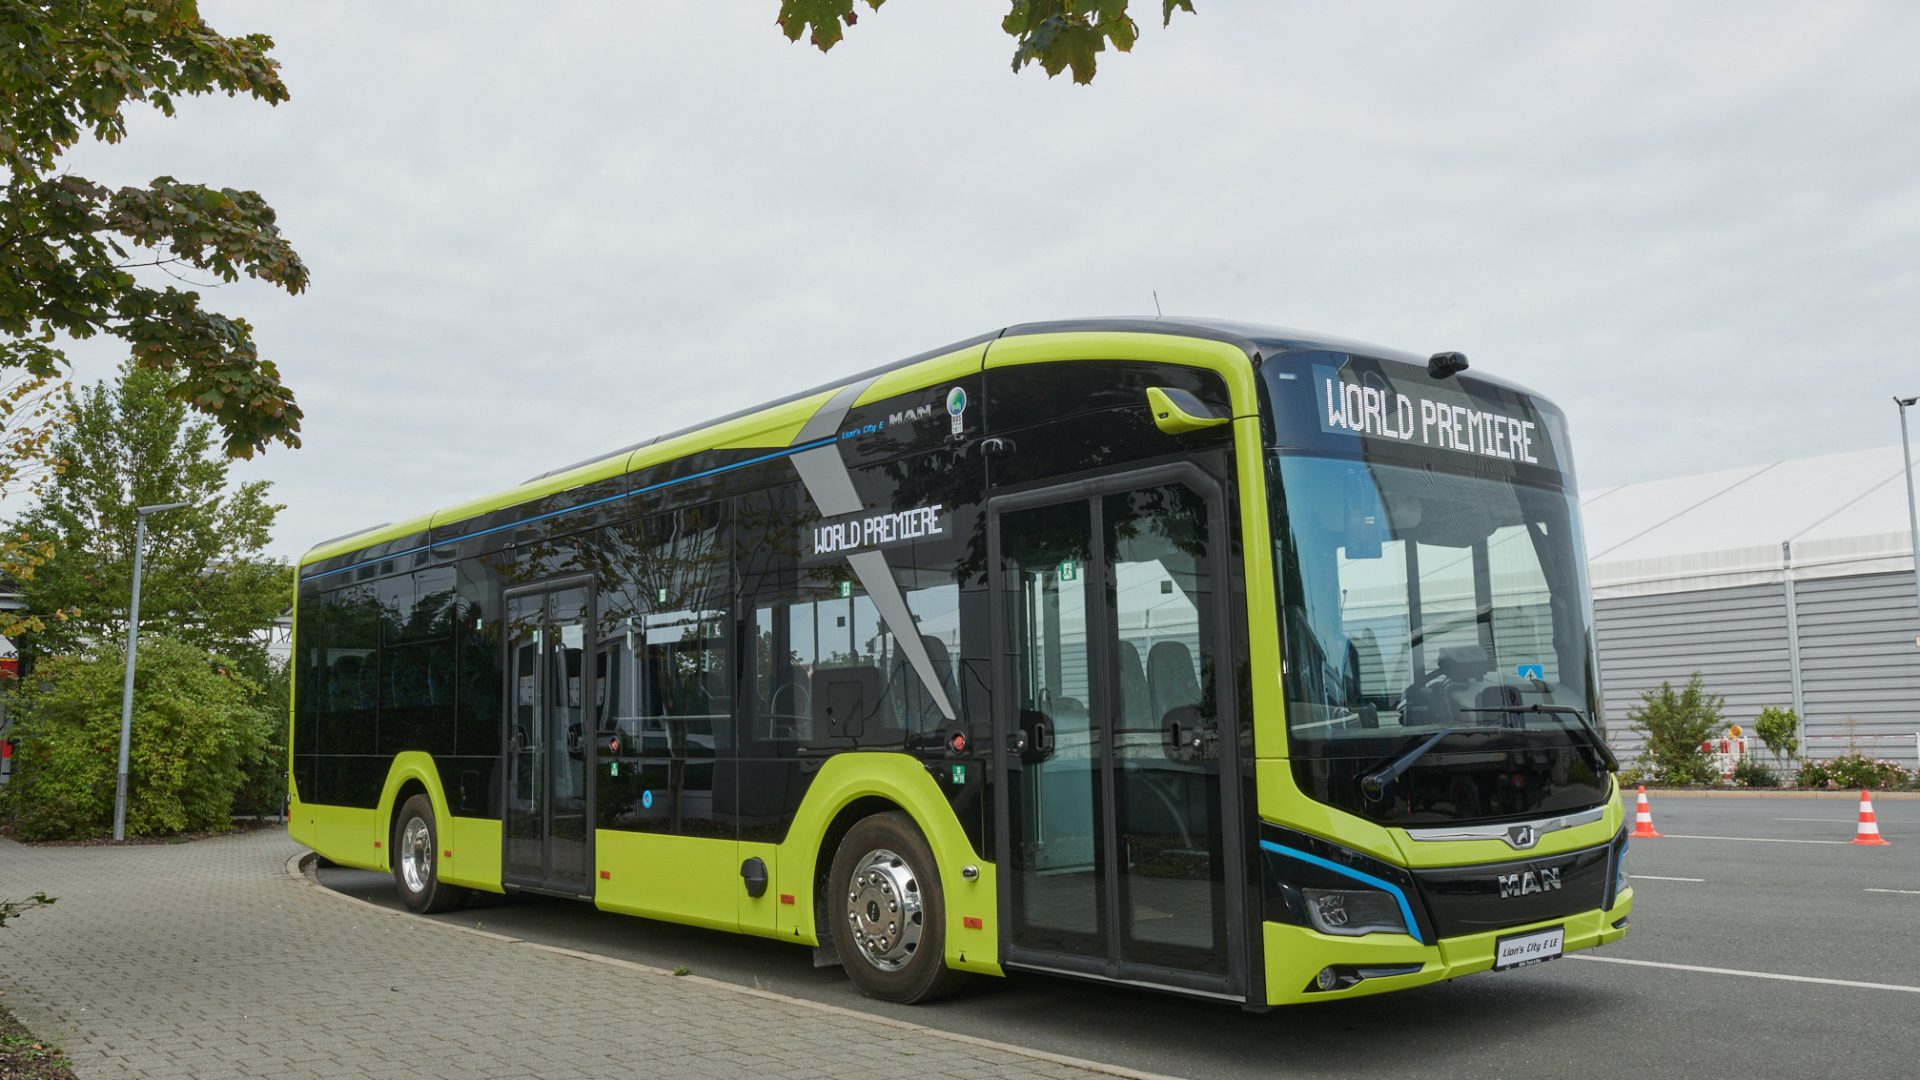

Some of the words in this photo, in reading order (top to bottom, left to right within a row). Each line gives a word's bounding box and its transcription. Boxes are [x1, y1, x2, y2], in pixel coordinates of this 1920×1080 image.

[889, 404, 932, 427] MAN
[1326, 378, 1413, 441] WORLD
[1420, 399, 1538, 464] PREMIERE
[841, 428, 861, 439] Lion's
[863, 424, 877, 434] City
[879, 420, 884, 430] E
[814, 521, 861, 555] WORLD
[864, 504, 943, 546] PREMIERE
[1498, 867, 1562, 899] MAN
[1503, 945, 1524, 957] Lion's
[1527, 941, 1541, 952] City
[1543, 940, 1548, 949] E
[1550, 937, 1558, 947] LE
